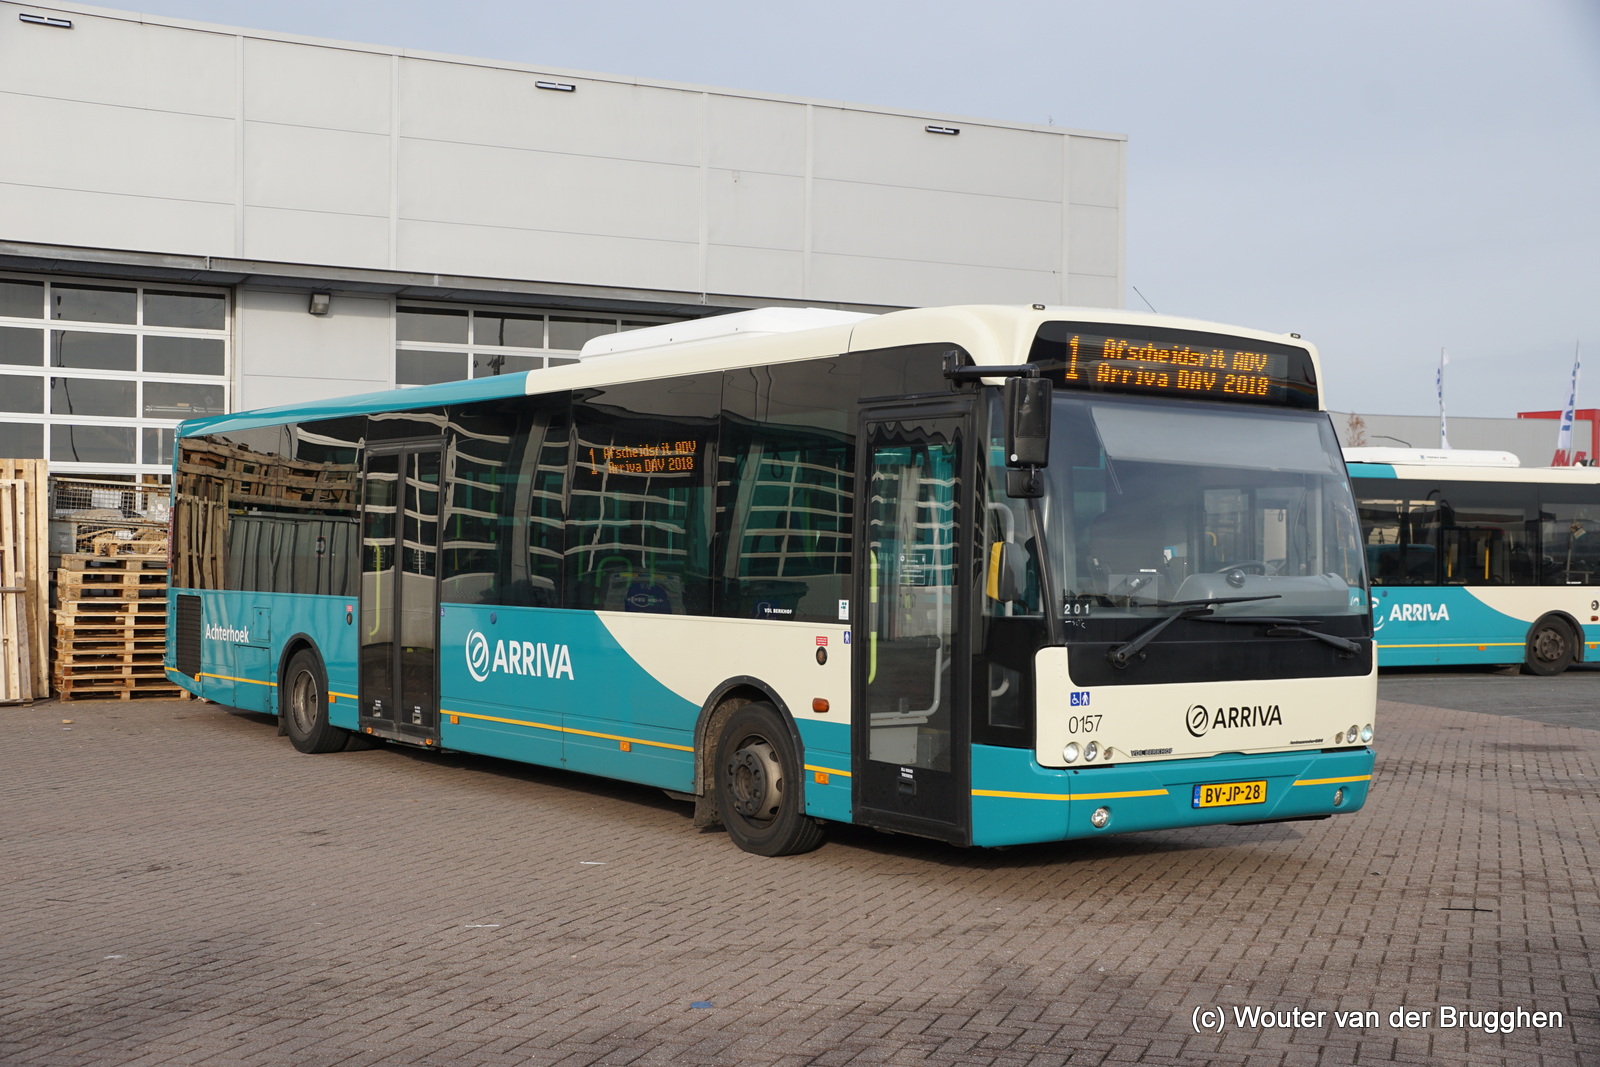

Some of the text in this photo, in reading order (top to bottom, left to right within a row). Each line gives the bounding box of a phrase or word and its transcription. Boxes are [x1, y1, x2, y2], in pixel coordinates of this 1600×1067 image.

[1066, 335, 1079, 380] 1
[1103, 339, 1268, 373] Afscheidsrit ADV
[1097, 362, 1269, 395] Arriva DAV 2018
[603, 440, 697, 460] Afscheidsrit ADV
[608, 456, 694, 474] Arriva DAV 2018
[1388, 603, 1450, 622] ARRIVA
[205, 623, 250, 644] Achterhoek
[492, 639, 575, 681] ARRIVA
[1068, 714, 1103, 734] 0157
[1212, 705, 1283, 729] ARRIVA
[1205, 784, 1261, 804] BV-JP-28
